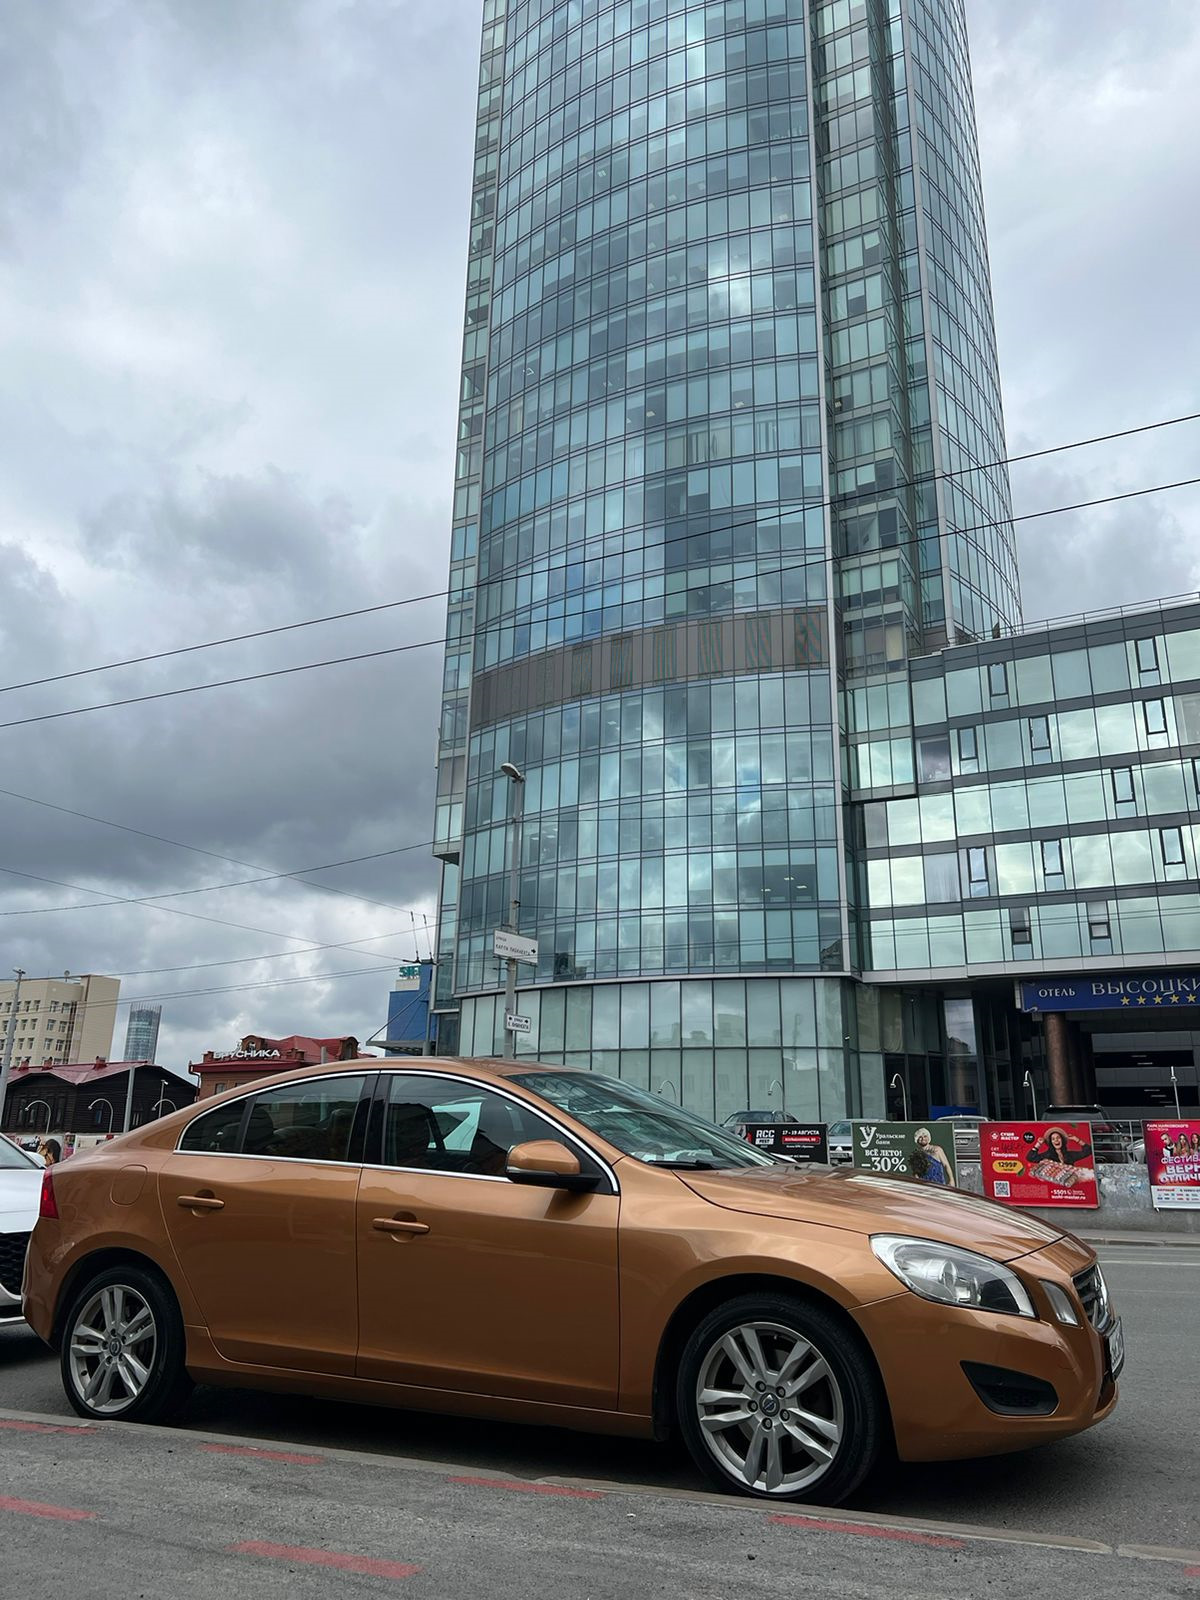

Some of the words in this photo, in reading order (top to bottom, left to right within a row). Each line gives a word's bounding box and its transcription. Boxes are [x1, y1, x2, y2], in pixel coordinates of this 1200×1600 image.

[1038, 987, 1076, 998] ОТЕЛЬ
[756, 1130, 775, 1138] RCC
[865, 1149, 879, 1157] ВСЁ
[880, 1149, 903, 1157] ЛЕТО!
[1160, 1155, 1200, 1164] ФЕСТИВ
